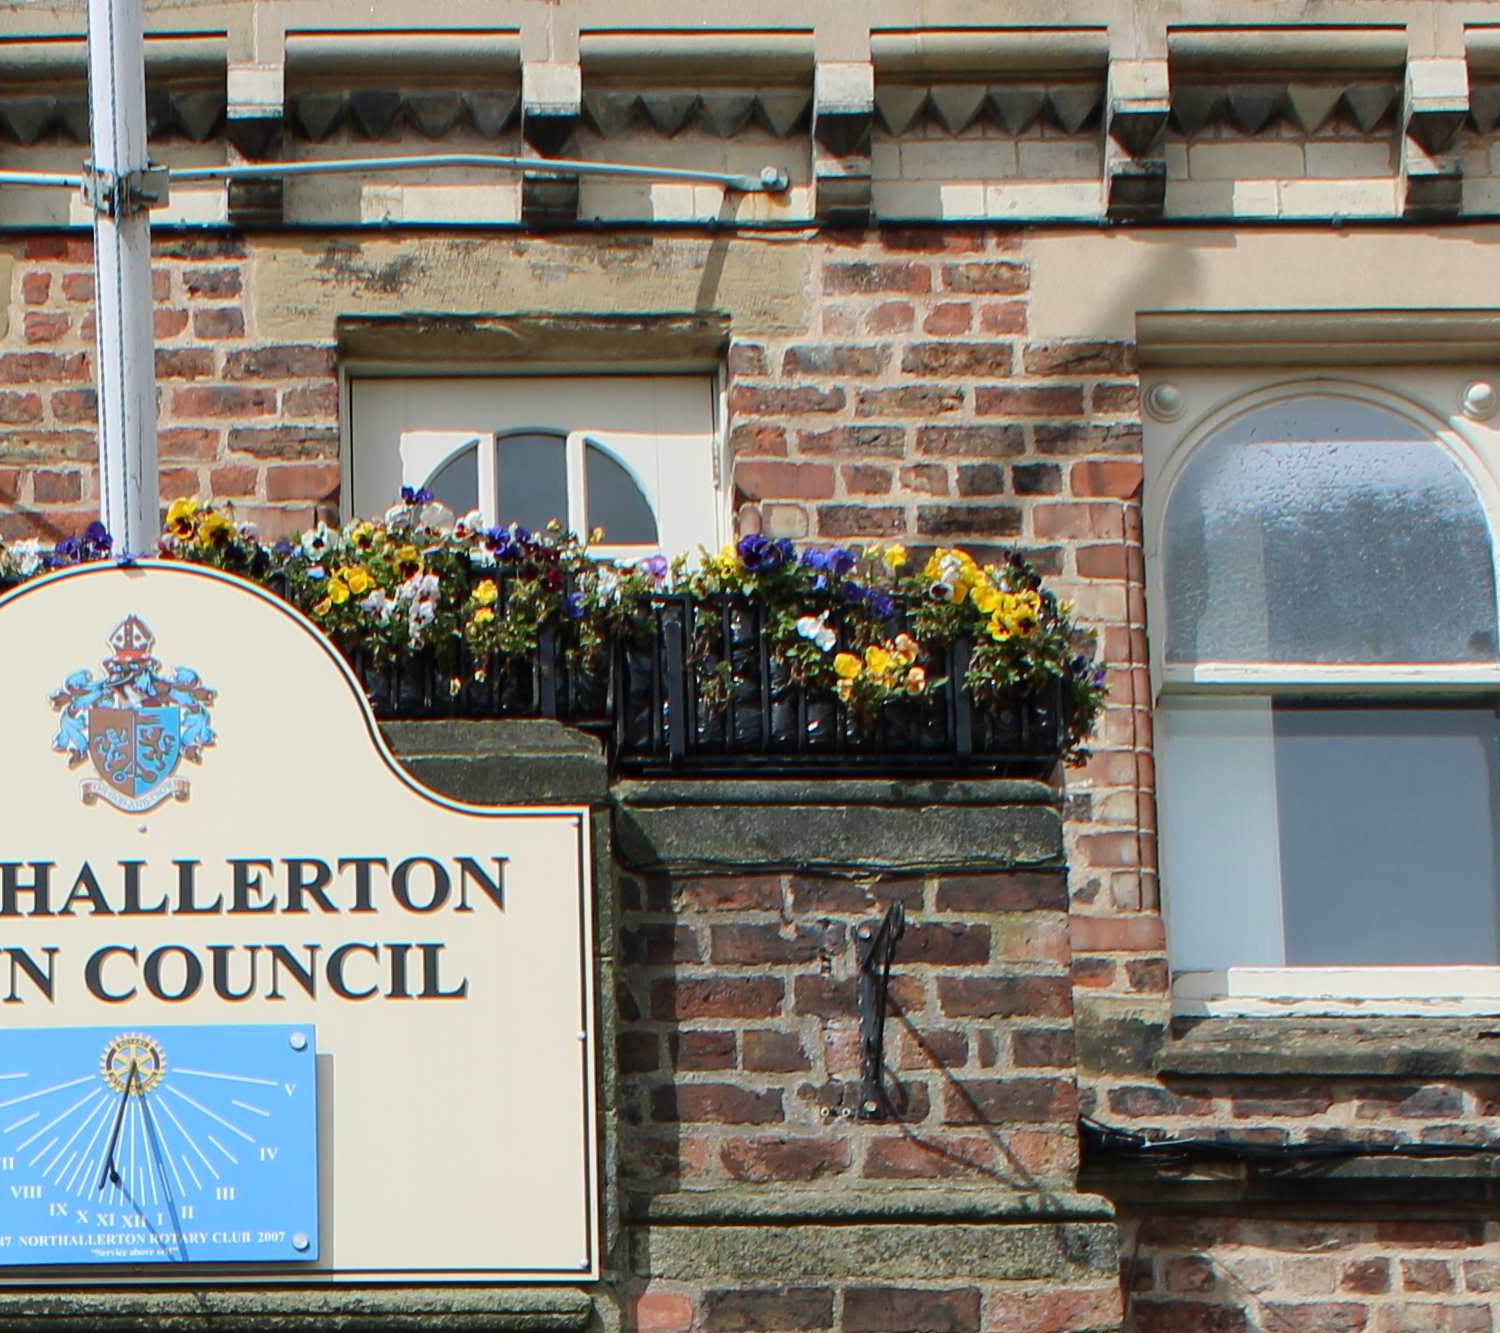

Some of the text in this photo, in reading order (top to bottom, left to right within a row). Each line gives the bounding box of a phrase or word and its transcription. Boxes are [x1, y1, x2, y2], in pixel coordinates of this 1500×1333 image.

[84, 942, 468, 1003] COUNCIL
[284, 1083, 297, 1097] V
[260, 1147, 278, 1161] IV
[10, 1185, 43, 1200] VIII
[216, 1187, 236, 1200] III
[50, 1203, 68, 1217] IX
[77, 1210, 89, 1224] X
[181, 1206, 194, 1220] II
[96, 1213, 116, 1227] XI
[122, 1214, 147, 1229] XII
[19, 1233, 146, 1247] NORTHALLERTON
[150, 1232, 209, 1245] ROTARY
[212, 1231, 251, 1244] CLUB
[257, 1231, 286, 1243] 2007
